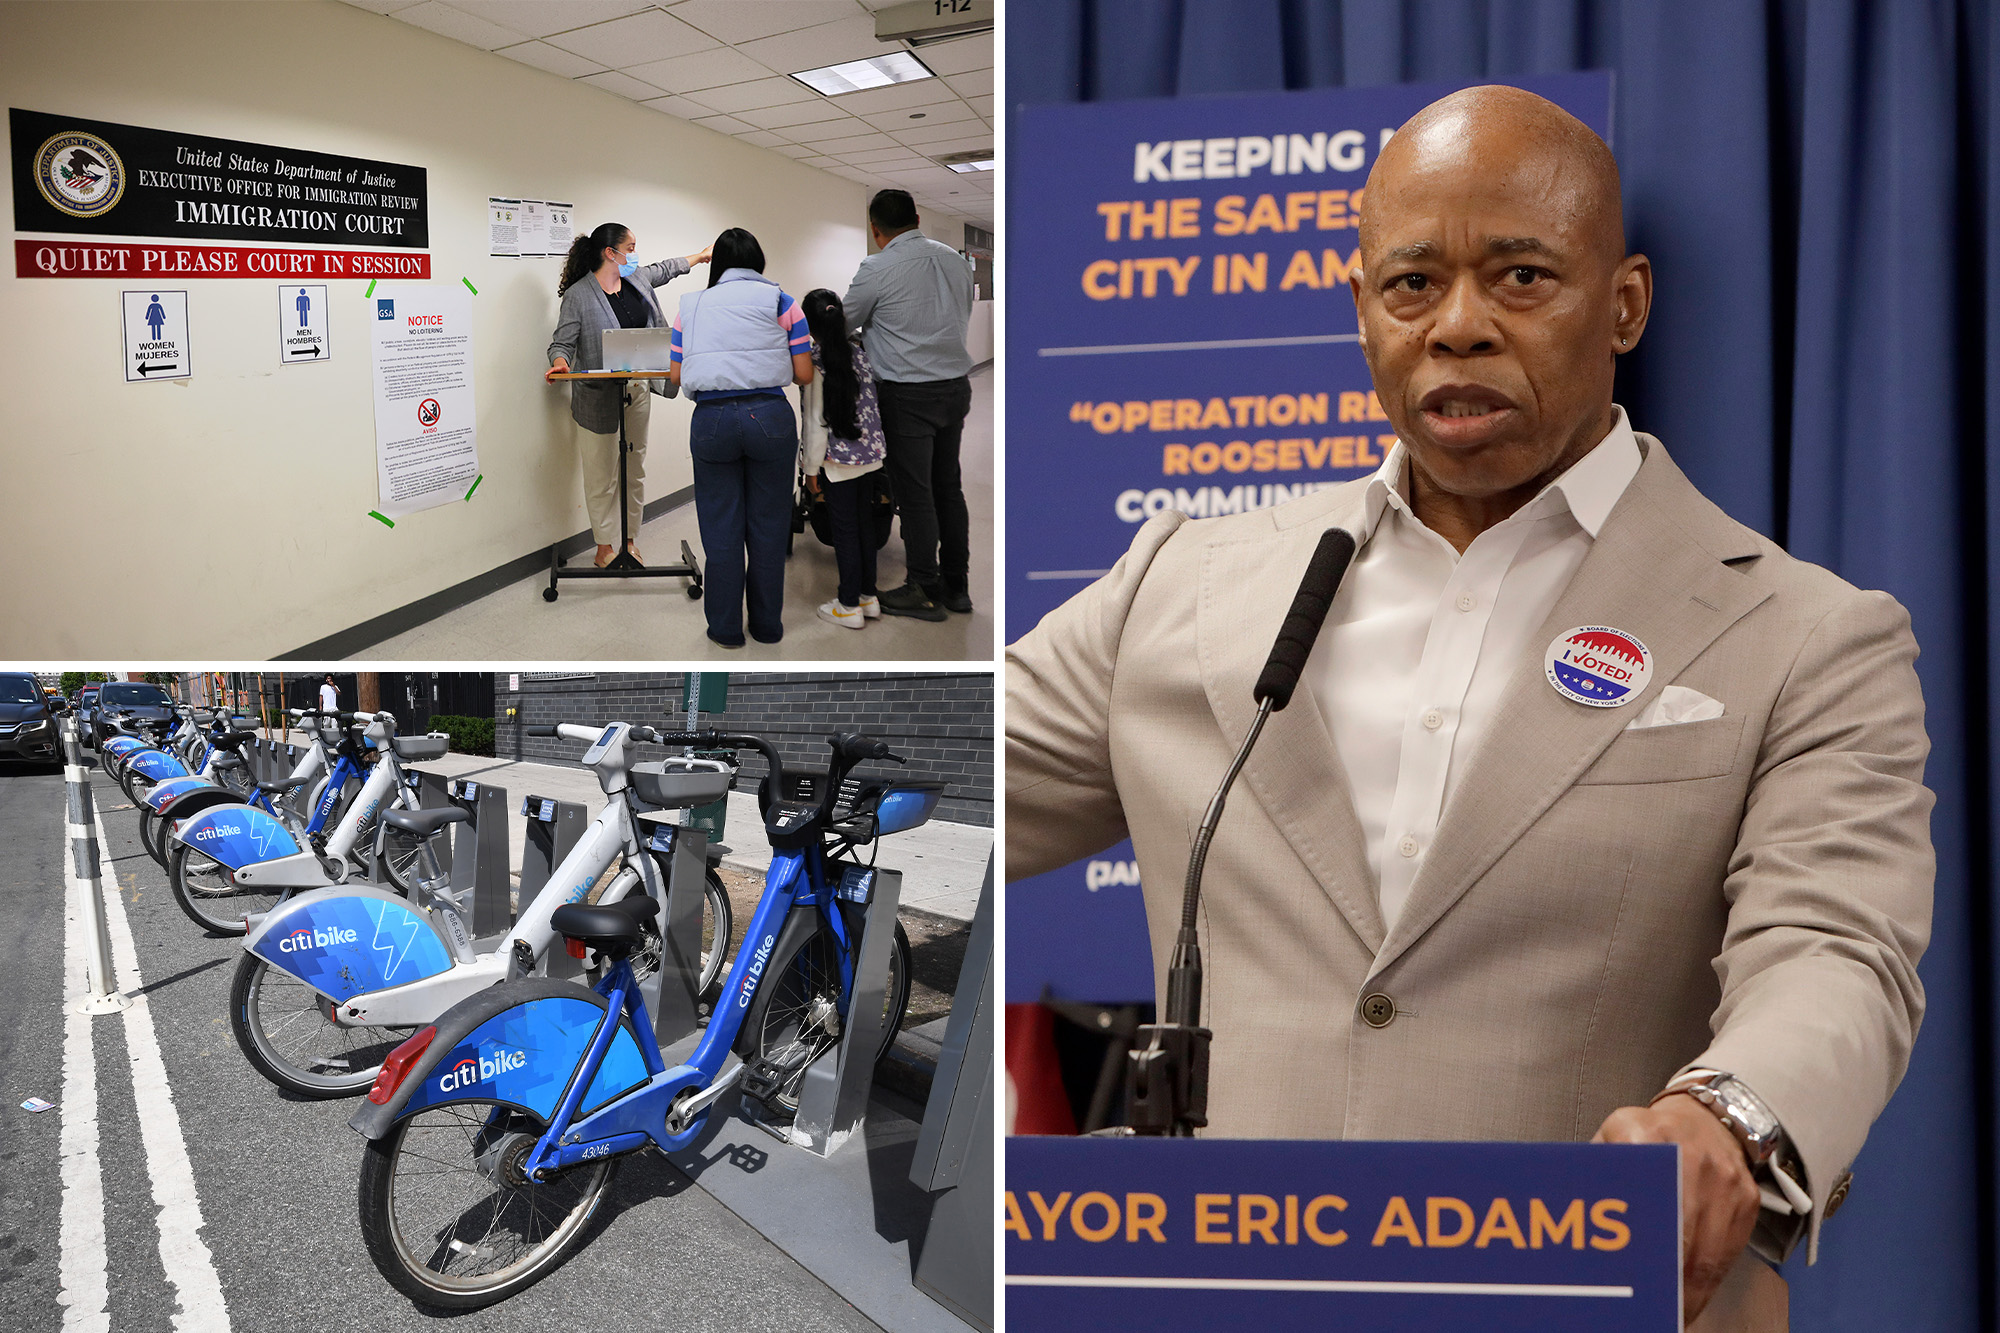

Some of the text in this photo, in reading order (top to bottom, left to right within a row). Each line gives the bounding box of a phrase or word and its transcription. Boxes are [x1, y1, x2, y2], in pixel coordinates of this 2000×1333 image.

[41, 138, 85, 177] DEPARTMENT
[86, 141, 101, 150] OF
[99, 149, 119, 185] JUSTICE
[176, 146, 396, 189] United States Department of Justice
[1134, 129, 1366, 182] KEEPING
[138, 169, 419, 210] EXECUTIVE OFFICE FOR IMMIGRATION REVIEW
[175, 200, 405, 236] IMMIGRATION COURT
[1097, 197, 1201, 242] THE
[36, 247, 422, 274] QUIET PLEASE COURT IN SESSION
[1081, 255, 1200, 300] CITY
[1212, 252, 1269, 294] IN
[379, 309, 394, 318] GSA
[408, 315, 443, 326] NOTICE
[135, 350, 179, 360] MUJERES
[139, 341, 175, 351] WOMEN
[287, 336, 322, 345] HOMBRES
[1620, 632, 1645, 651] ELECTIONS
[1563, 649, 1633, 683] I VOTED!
[1553, 681, 1563, 691] THE
[1561, 688, 1574, 697] CITY
[196, 825, 241, 841] citi bike
[357, 799, 380, 833] citi bike
[566, 876, 595, 904] bike
[279, 926, 356, 953] citi bike
[739, 934, 774, 1008] citi bike
[440, 1049, 526, 1092] citi bike
[1195, 1193, 1349, 1247] ERIC
[1371, 1196, 1632, 1252] ADAMS
